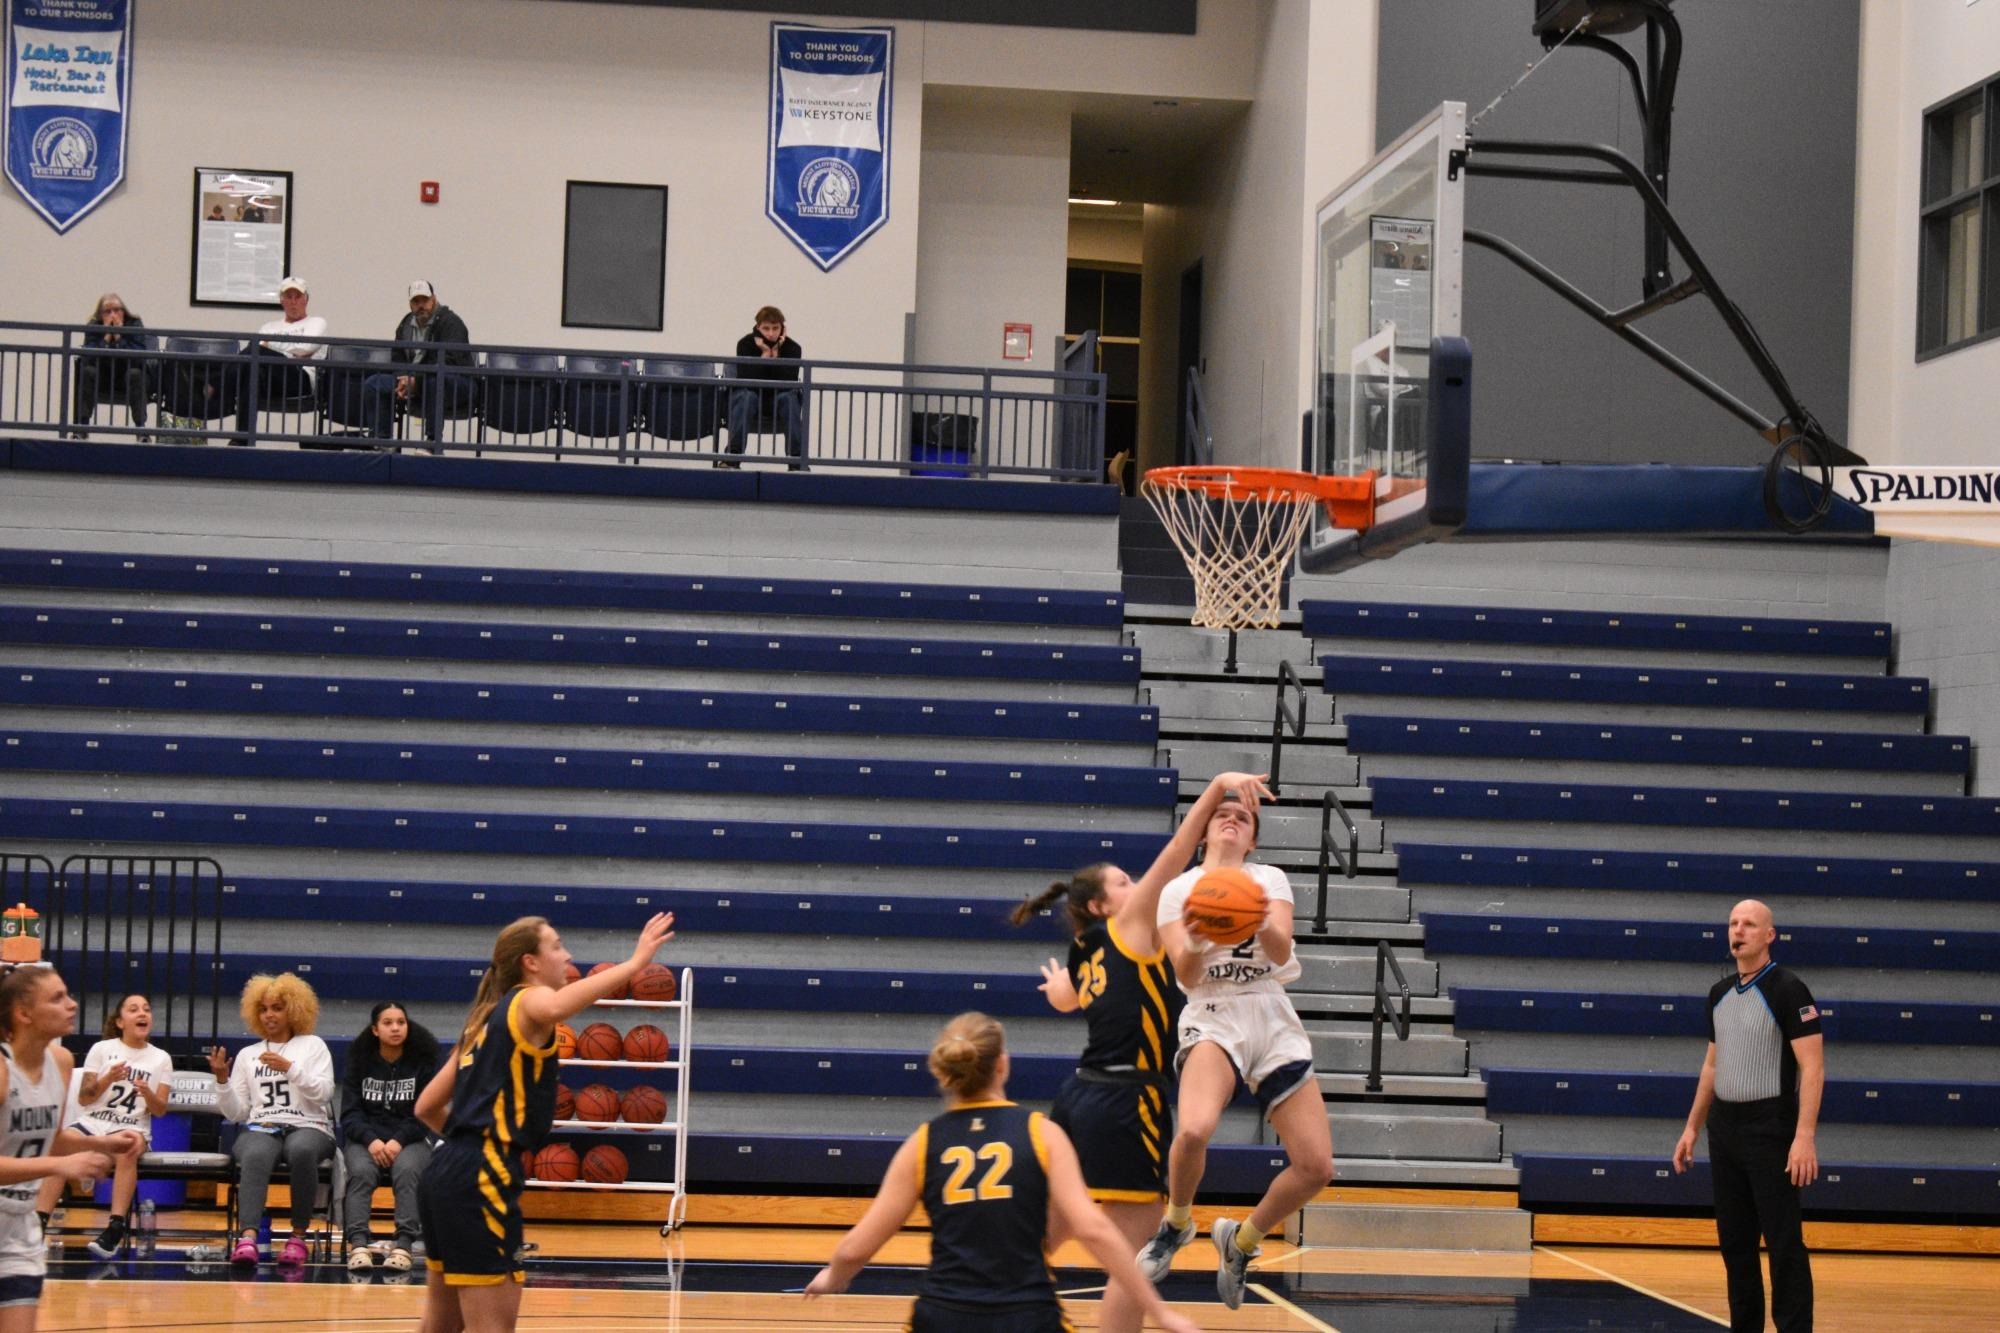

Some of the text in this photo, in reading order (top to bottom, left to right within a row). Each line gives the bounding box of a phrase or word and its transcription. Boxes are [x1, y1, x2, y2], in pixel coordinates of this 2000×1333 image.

[41, 0, 98, 9] THANK YOU
[24, 8, 114, 20] TO OUR SPONSORS
[805, 42, 859, 52] THANK YOU
[789, 51, 875, 64] TO OUR SPONSORS
[804, 109, 872, 121] KEYSTONE
[802, 205, 855, 216] VICTORY CLUB
[1077, 946, 1107, 1010] 25
[107, 1085, 137, 1114] 24
[260, 1080, 290, 1108] 35
[8, 1104, 58, 1133] MOUNT
[940, 1141, 1013, 1205] 22
